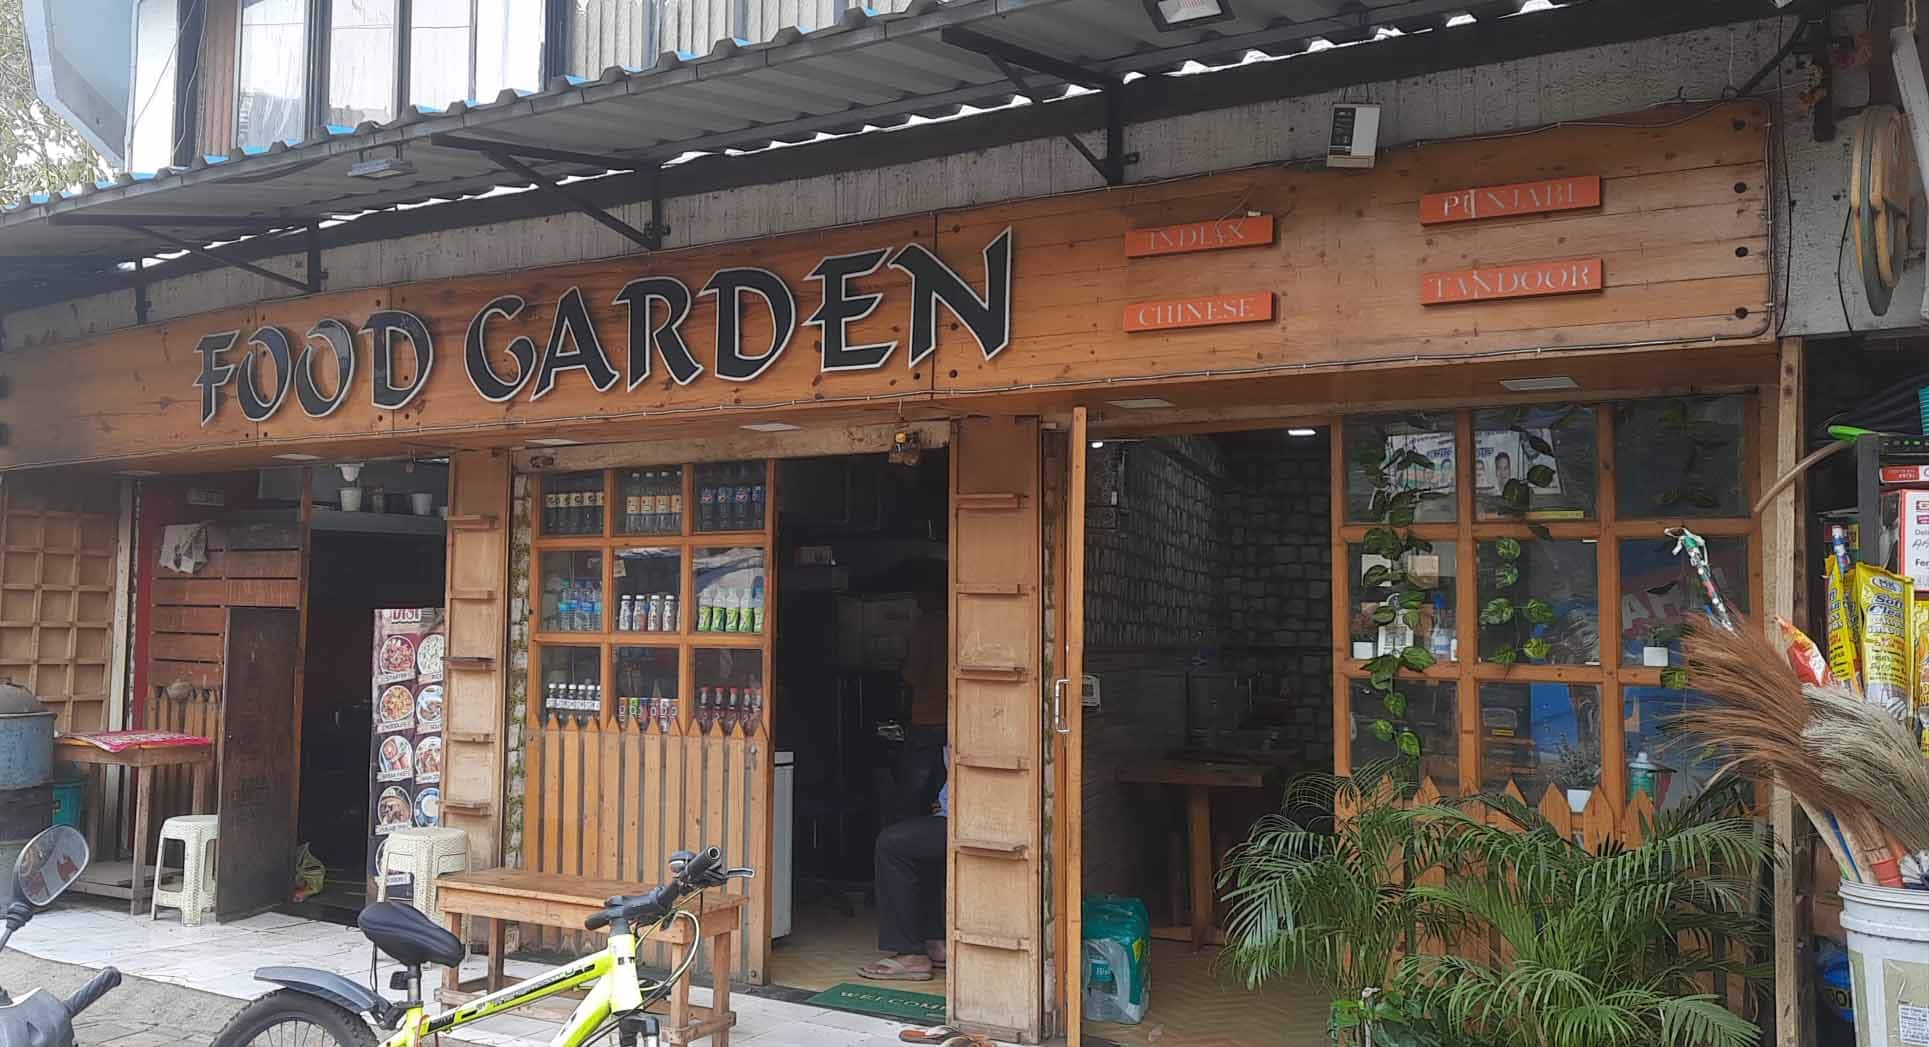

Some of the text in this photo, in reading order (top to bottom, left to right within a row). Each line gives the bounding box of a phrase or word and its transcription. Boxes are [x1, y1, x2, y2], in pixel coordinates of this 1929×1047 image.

[1423, 263, 1591, 300] TANDOOR
[193, 225, 1012, 426] FOOD GARDEN
[1138, 297, 1257, 325] CHINESE
[840, 991, 946, 1011] WELCOM
